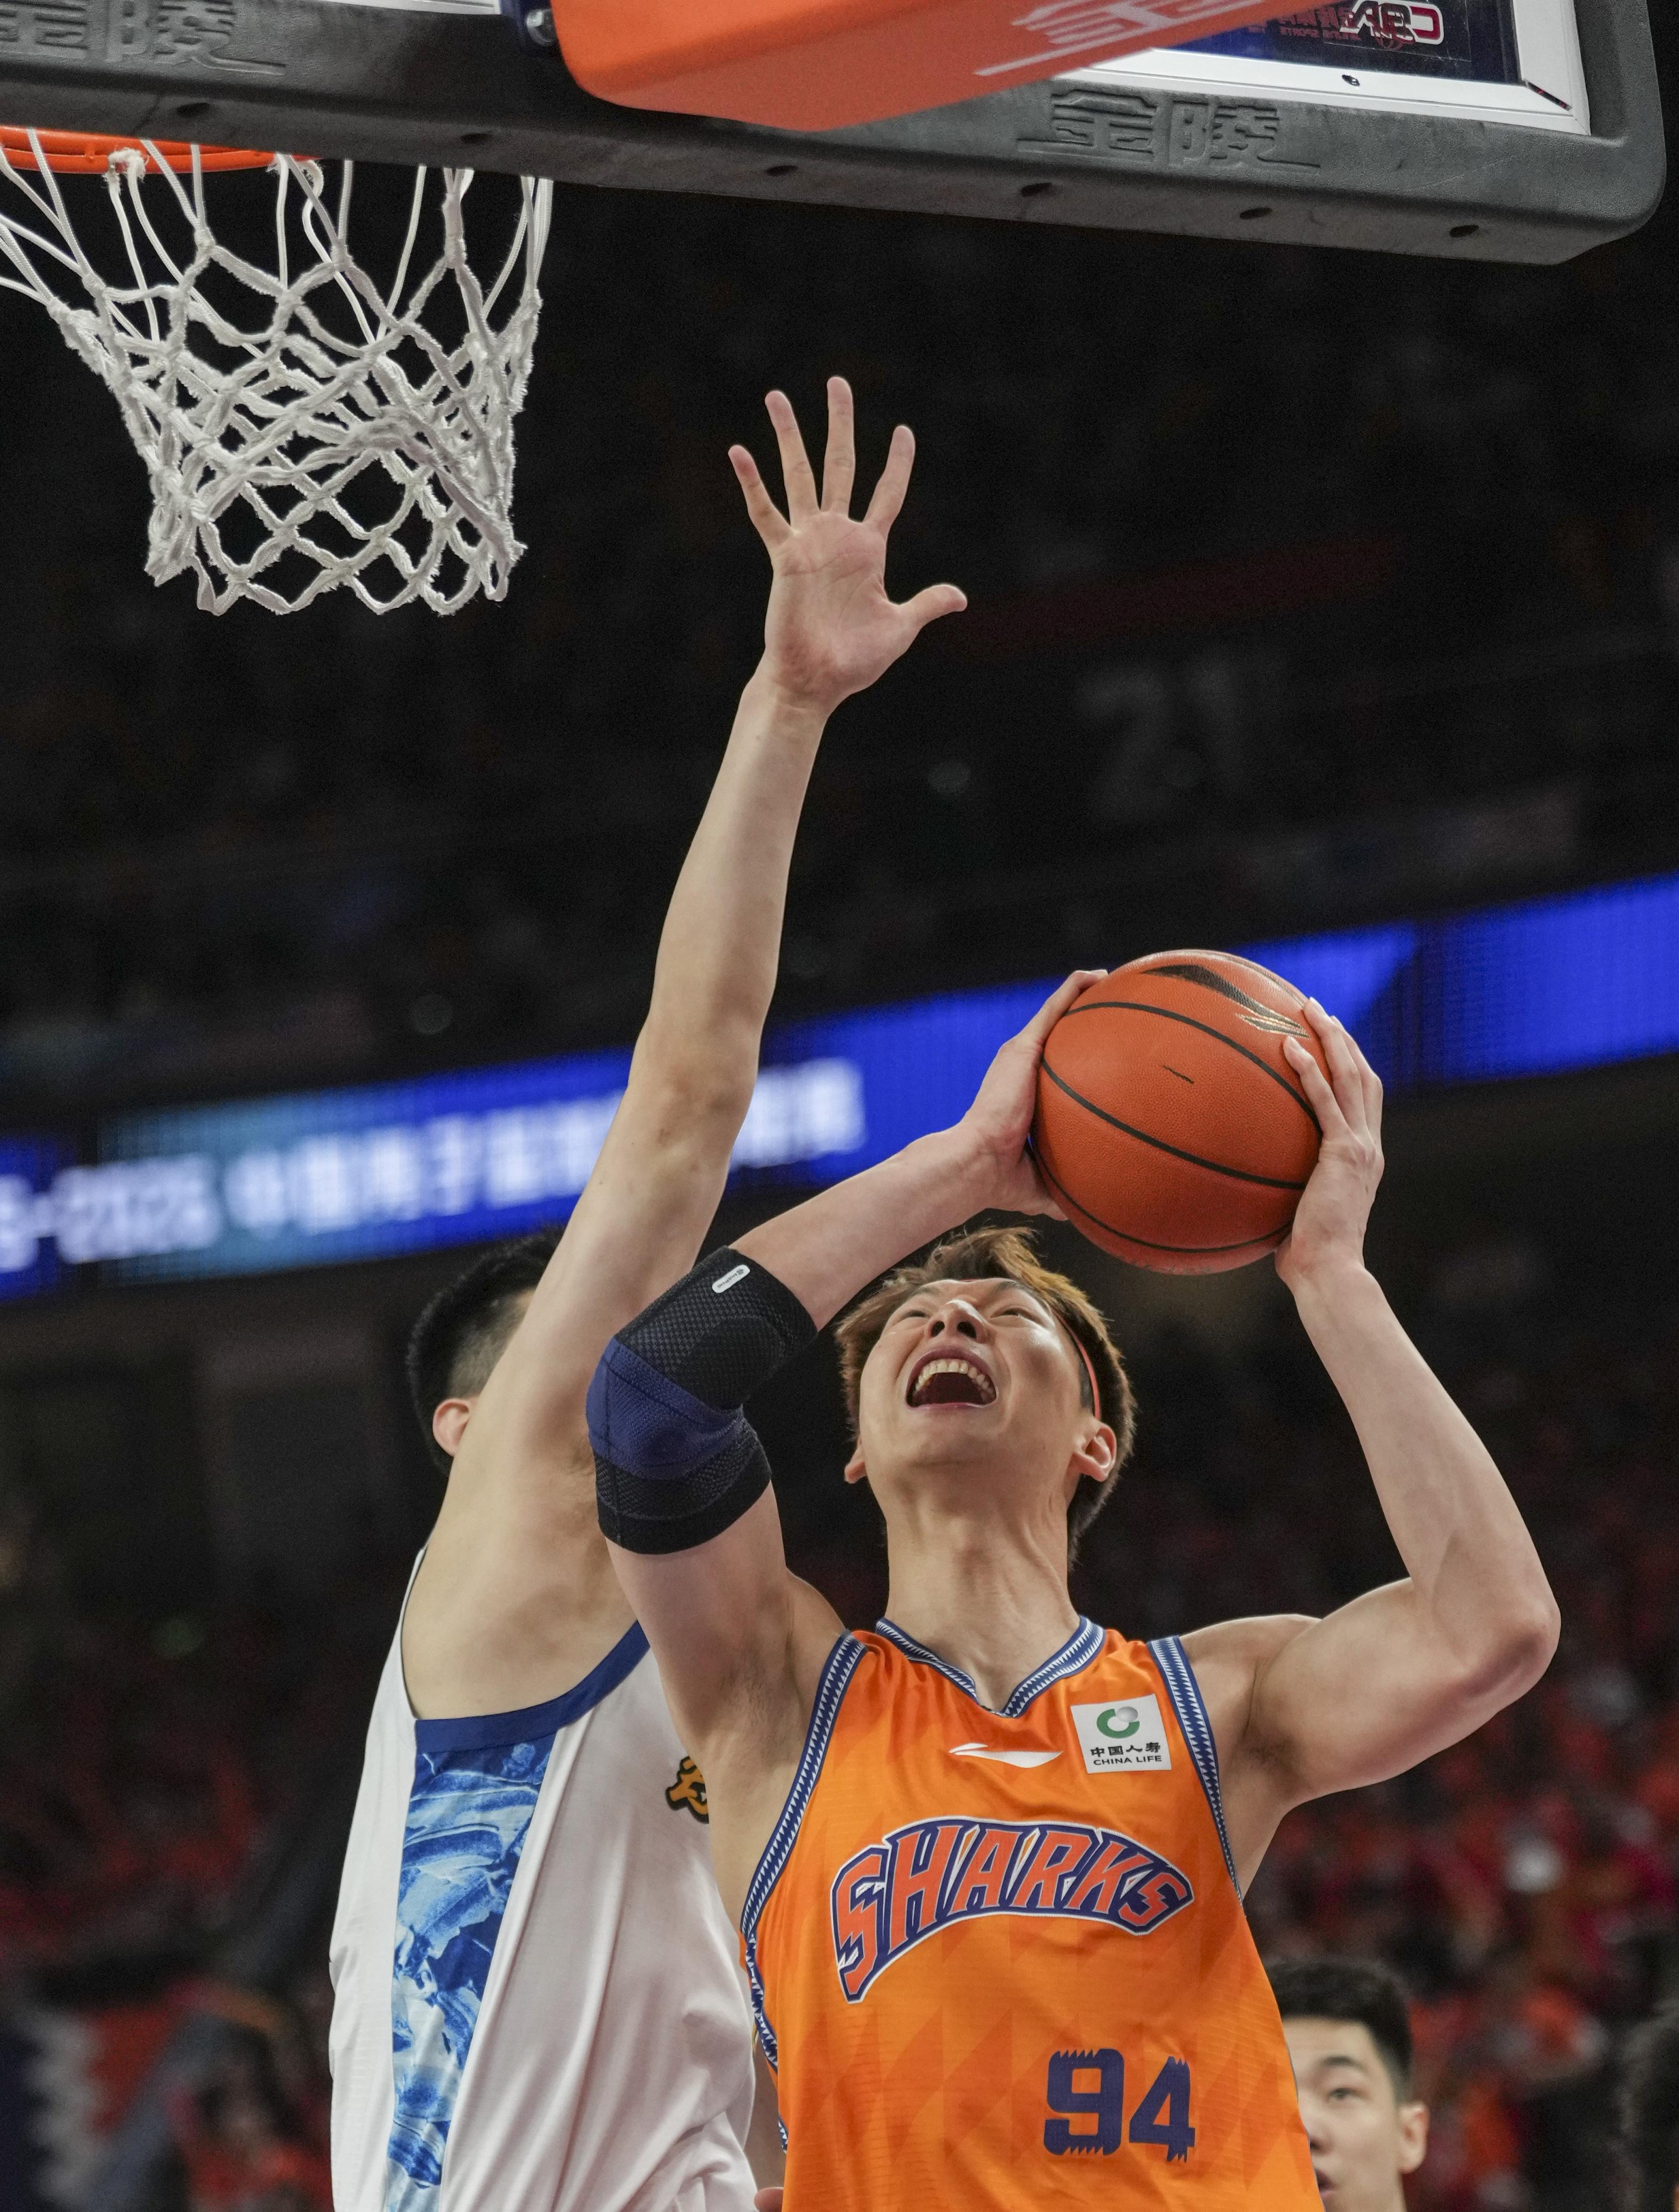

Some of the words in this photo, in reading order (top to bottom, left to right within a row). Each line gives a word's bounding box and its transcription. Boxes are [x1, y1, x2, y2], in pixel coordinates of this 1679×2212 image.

[1090, 1742, 1161, 1757] 中国人寿
[1093, 1757, 1132, 1766] CHINA
[830, 1815, 1195, 2004] SHARKS
[1043, 2048, 1195, 2162] 94
